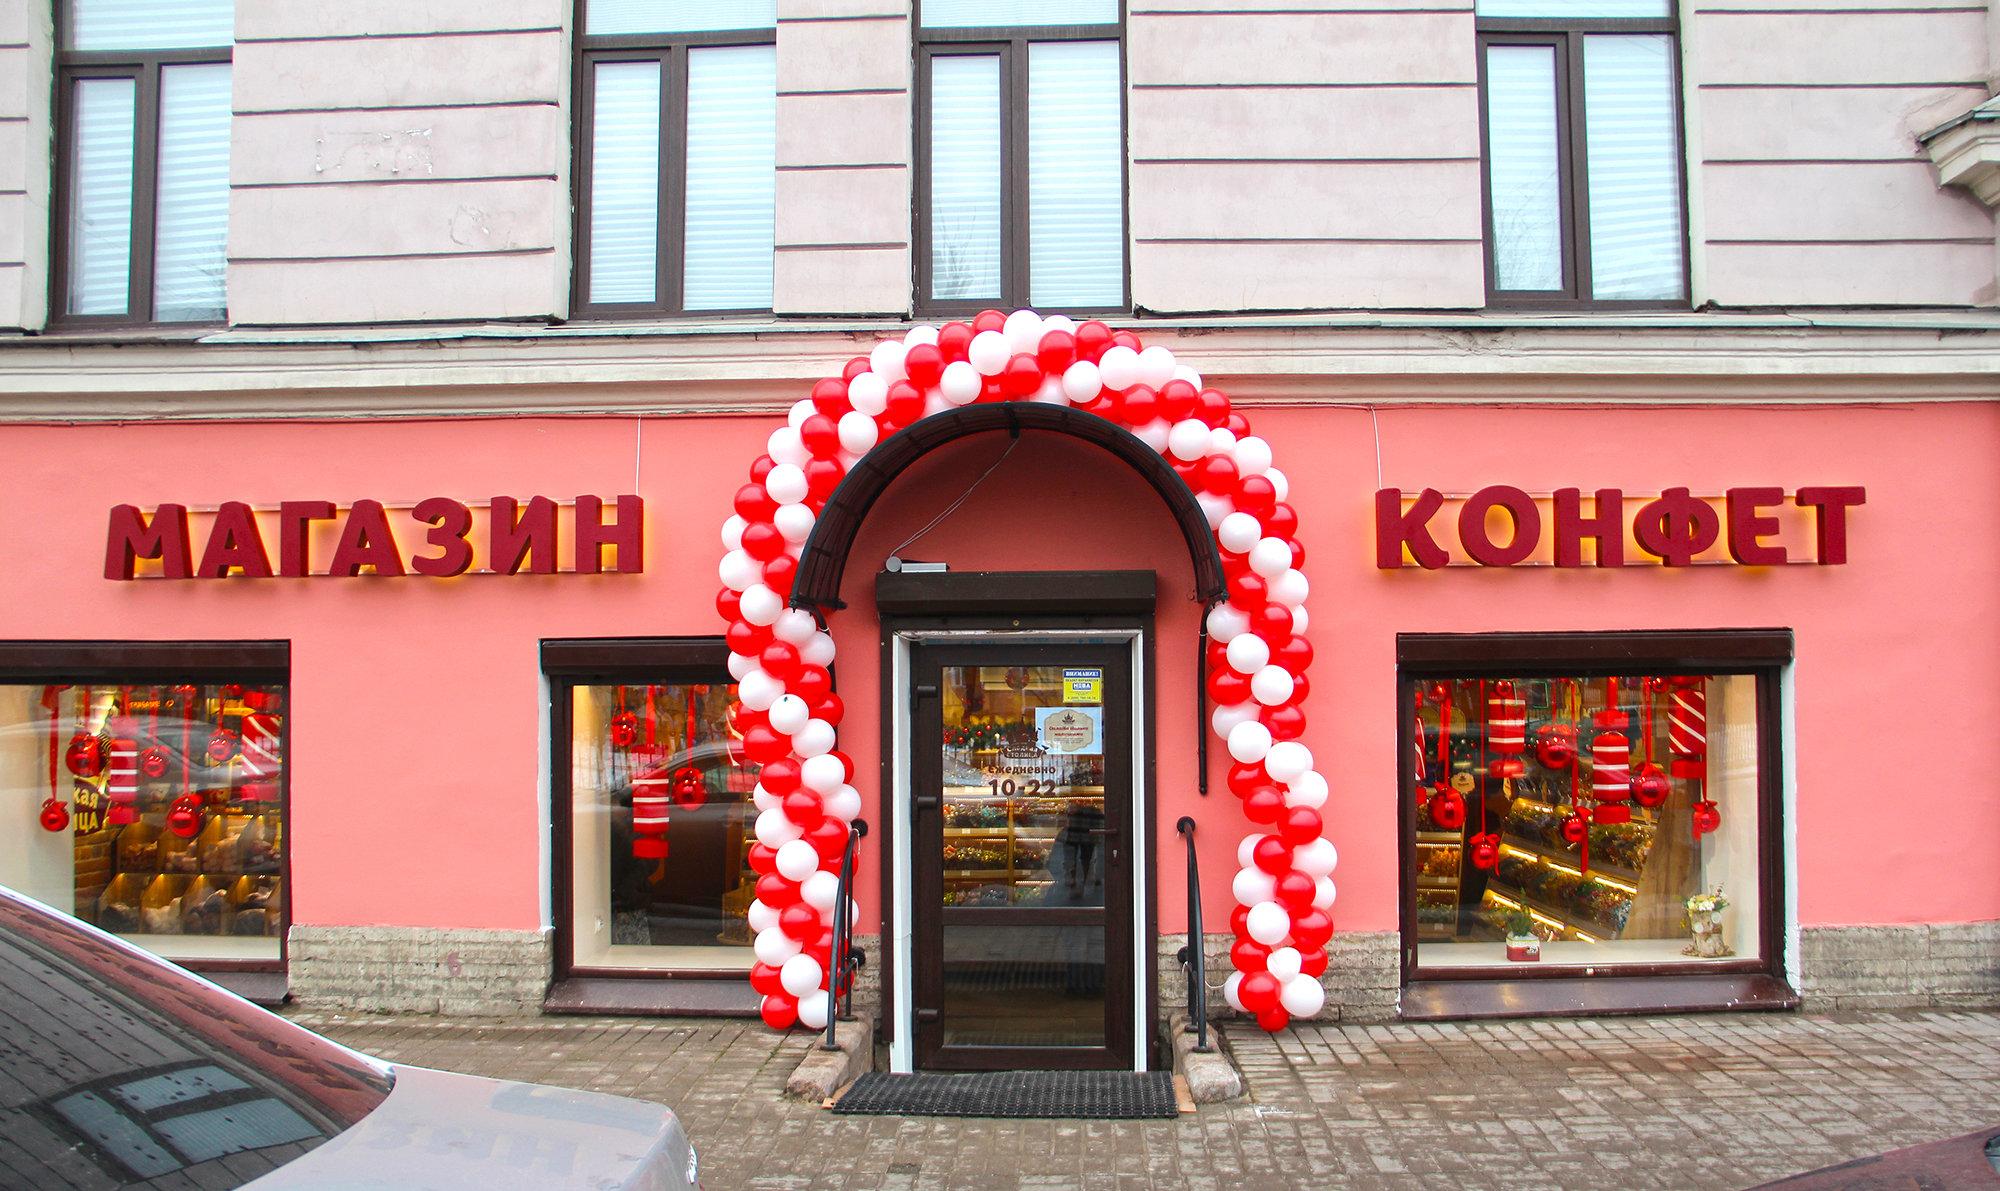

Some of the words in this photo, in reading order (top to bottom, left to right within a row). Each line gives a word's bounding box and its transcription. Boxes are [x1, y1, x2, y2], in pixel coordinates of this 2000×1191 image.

[104, 495, 643, 580] МАГАЗИН
[1375, 485, 1865, 569] КОНФЕТ
[988, 779, 1056, 796] 10-22
